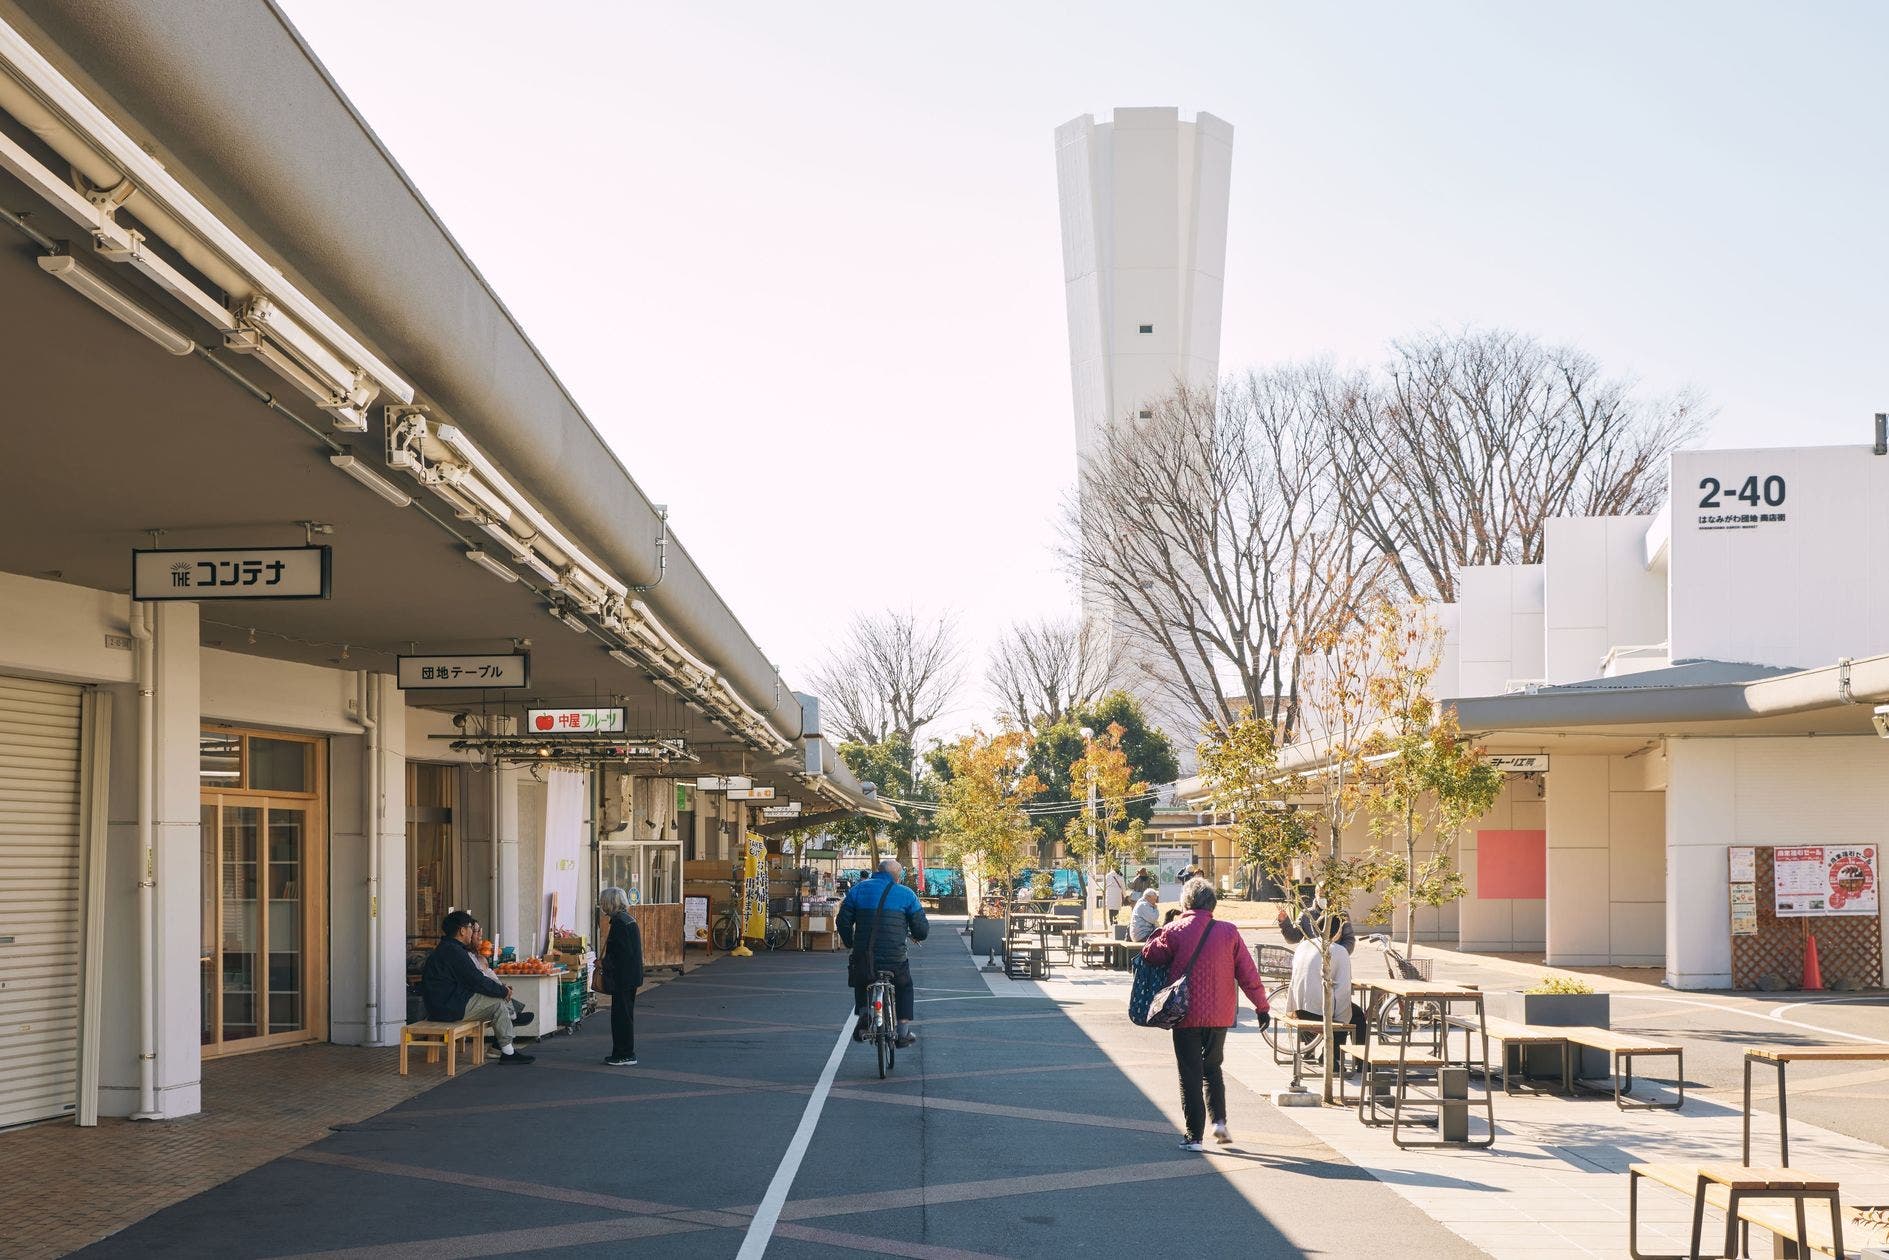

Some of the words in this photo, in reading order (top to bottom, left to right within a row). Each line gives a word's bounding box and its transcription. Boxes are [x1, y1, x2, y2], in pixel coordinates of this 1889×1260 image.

[1699, 475, 1786, 508] 2-40
[1699, 514, 1758, 523] はなみがわ団地
[171, 571, 191, 587] THE
[197, 560, 286, 586] コンテナ
[422, 665, 503, 680] 団地テーブル
[558, 712, 617, 729] 中屋フルーツ
